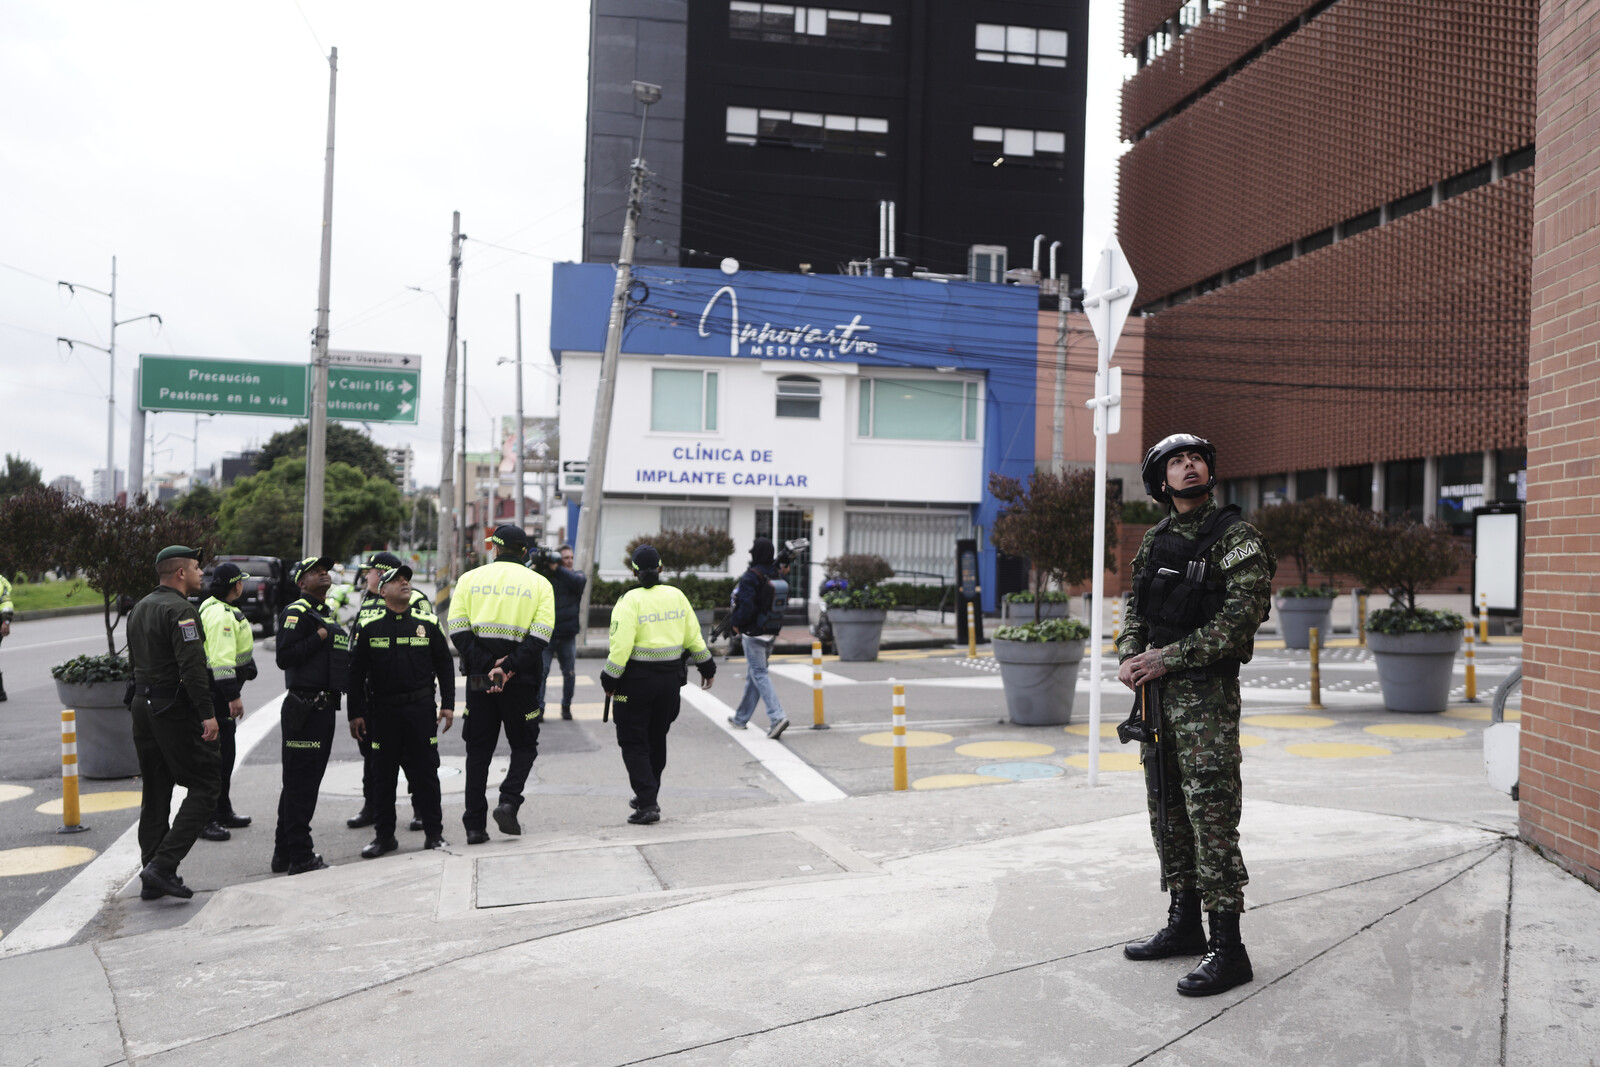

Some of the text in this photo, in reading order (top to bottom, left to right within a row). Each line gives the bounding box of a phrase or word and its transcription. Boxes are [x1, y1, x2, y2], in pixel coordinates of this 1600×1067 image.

[751, 345, 836, 359] MEDICAL
[189, 369, 260, 384] Precaución
[339, 378, 371, 390] Calle
[375, 380, 395, 392] 116
[160, 387, 288, 406] Peatones en la vía
[327, 399, 380, 411] utonorte
[673, 442, 773, 463] CLÍNICA DE
[636, 469, 808, 488] IMPLANTE CAPILAR
[1222, 541, 1256, 568] PM
[471, 584, 532, 600] POLICÍA
